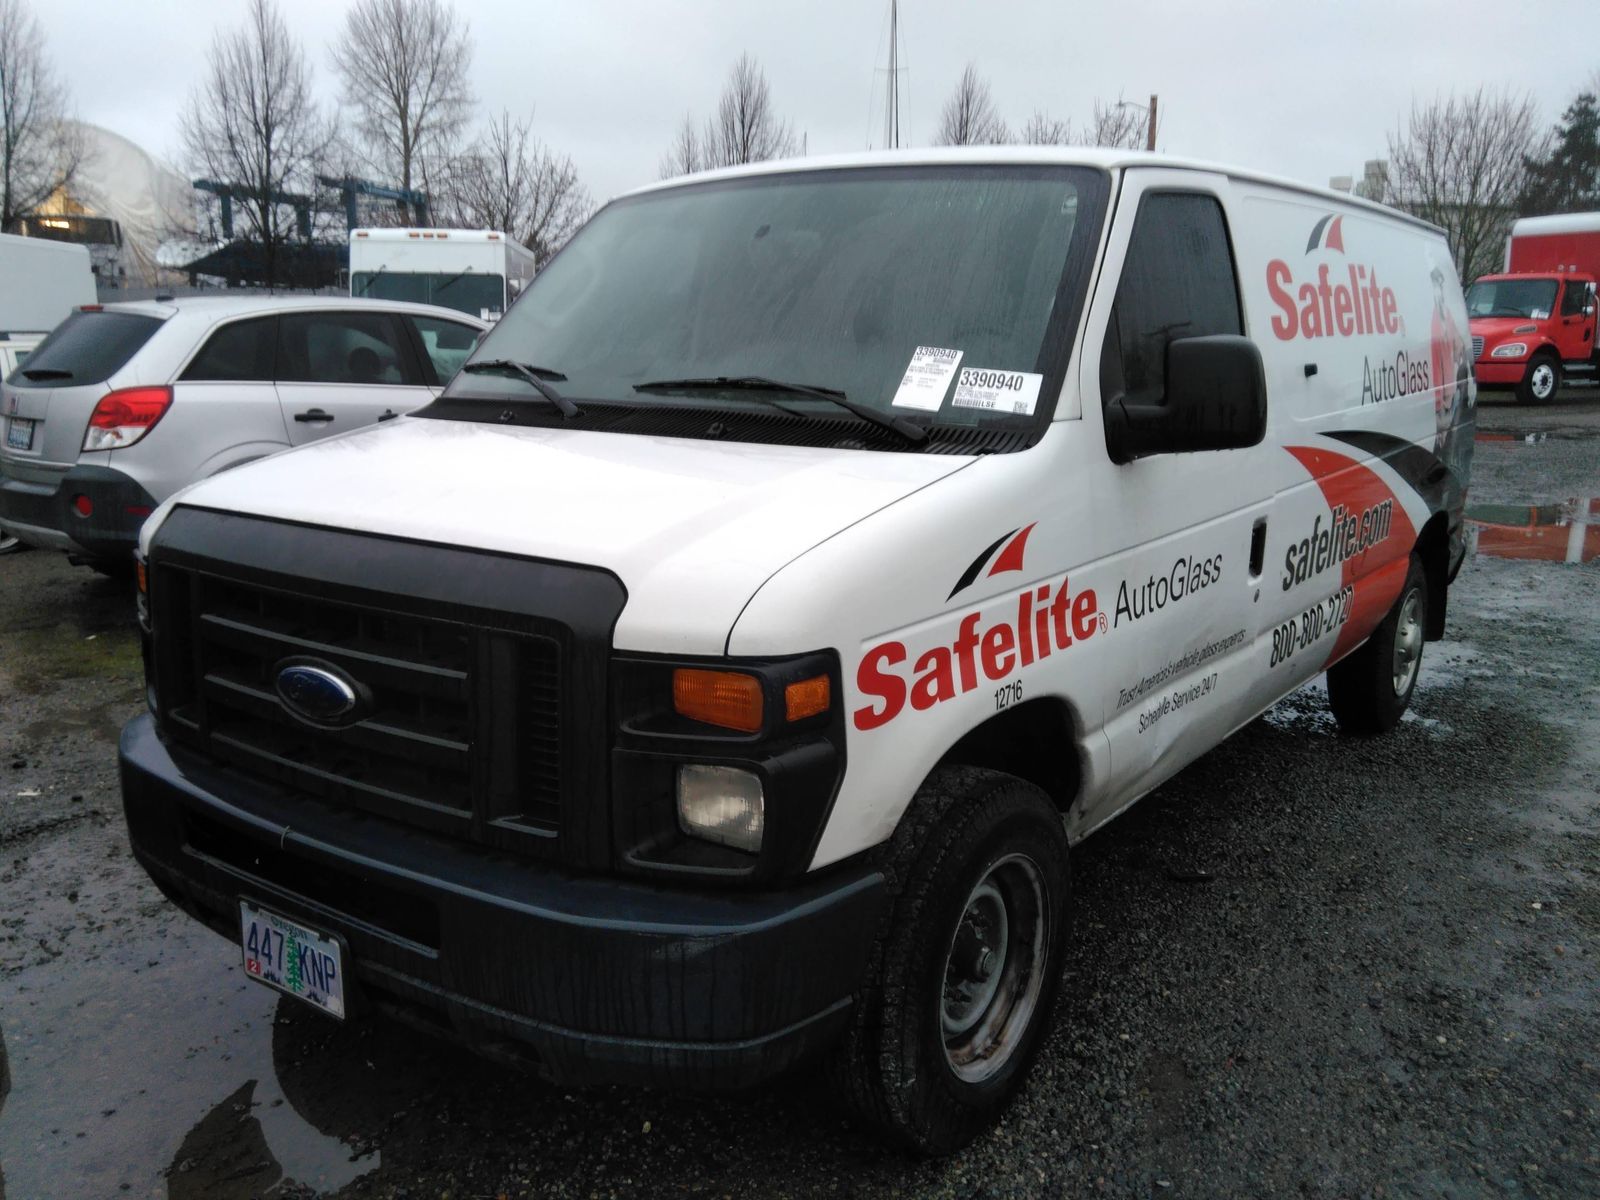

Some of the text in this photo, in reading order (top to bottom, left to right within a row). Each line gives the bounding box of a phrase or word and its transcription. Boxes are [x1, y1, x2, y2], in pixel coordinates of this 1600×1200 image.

[1266, 258, 1399, 341] Safelite
[916, 346, 958, 359] 3390940
[960, 370, 1024, 391] 3390940
[1361, 351, 1430, 406] AutoGlass
[1282, 497, 1393, 592] safelite.com
[1113, 553, 1223, 629] AutoGlass
[1269, 585, 1355, 669] 800-800-2727
[993, 679, 1023, 711] 12716
[1170, 684, 1201, 712] Service
[1200, 672, 1218, 697] 24/7
[247, 921, 336, 995] 447 KNP
